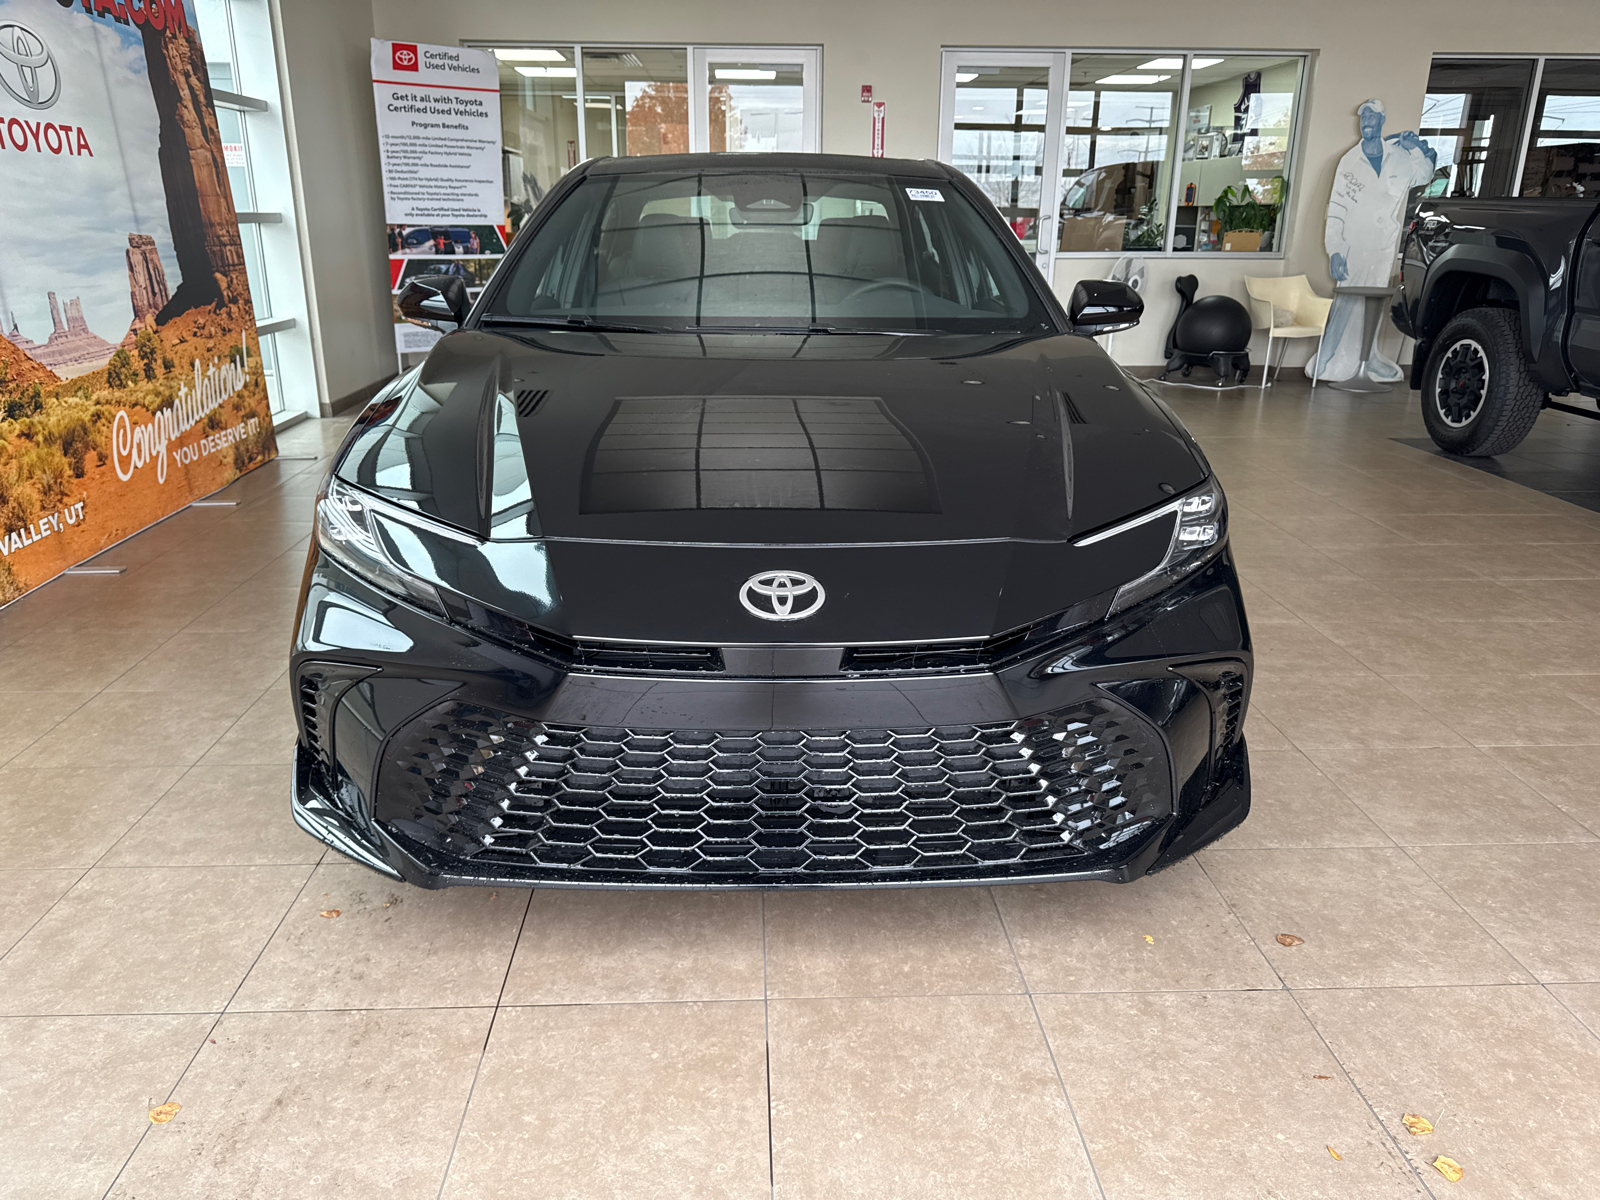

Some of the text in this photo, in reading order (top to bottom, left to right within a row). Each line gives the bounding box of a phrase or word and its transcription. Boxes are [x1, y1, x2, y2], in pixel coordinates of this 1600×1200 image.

[424, 50, 460, 62] Certified
[424, 61, 481, 75] Used Vehicles
[392, 92, 483, 108] Get it all with Toyota
[387, 103, 489, 119] Certified Used Vehicles
[411, 120, 469, 131] Program Benefits
[112, 329, 250, 484] Congratulations!
[173, 416, 261, 468] YOU DESERVE IT!
[0, 501, 84, 557] VALLEY, UT
